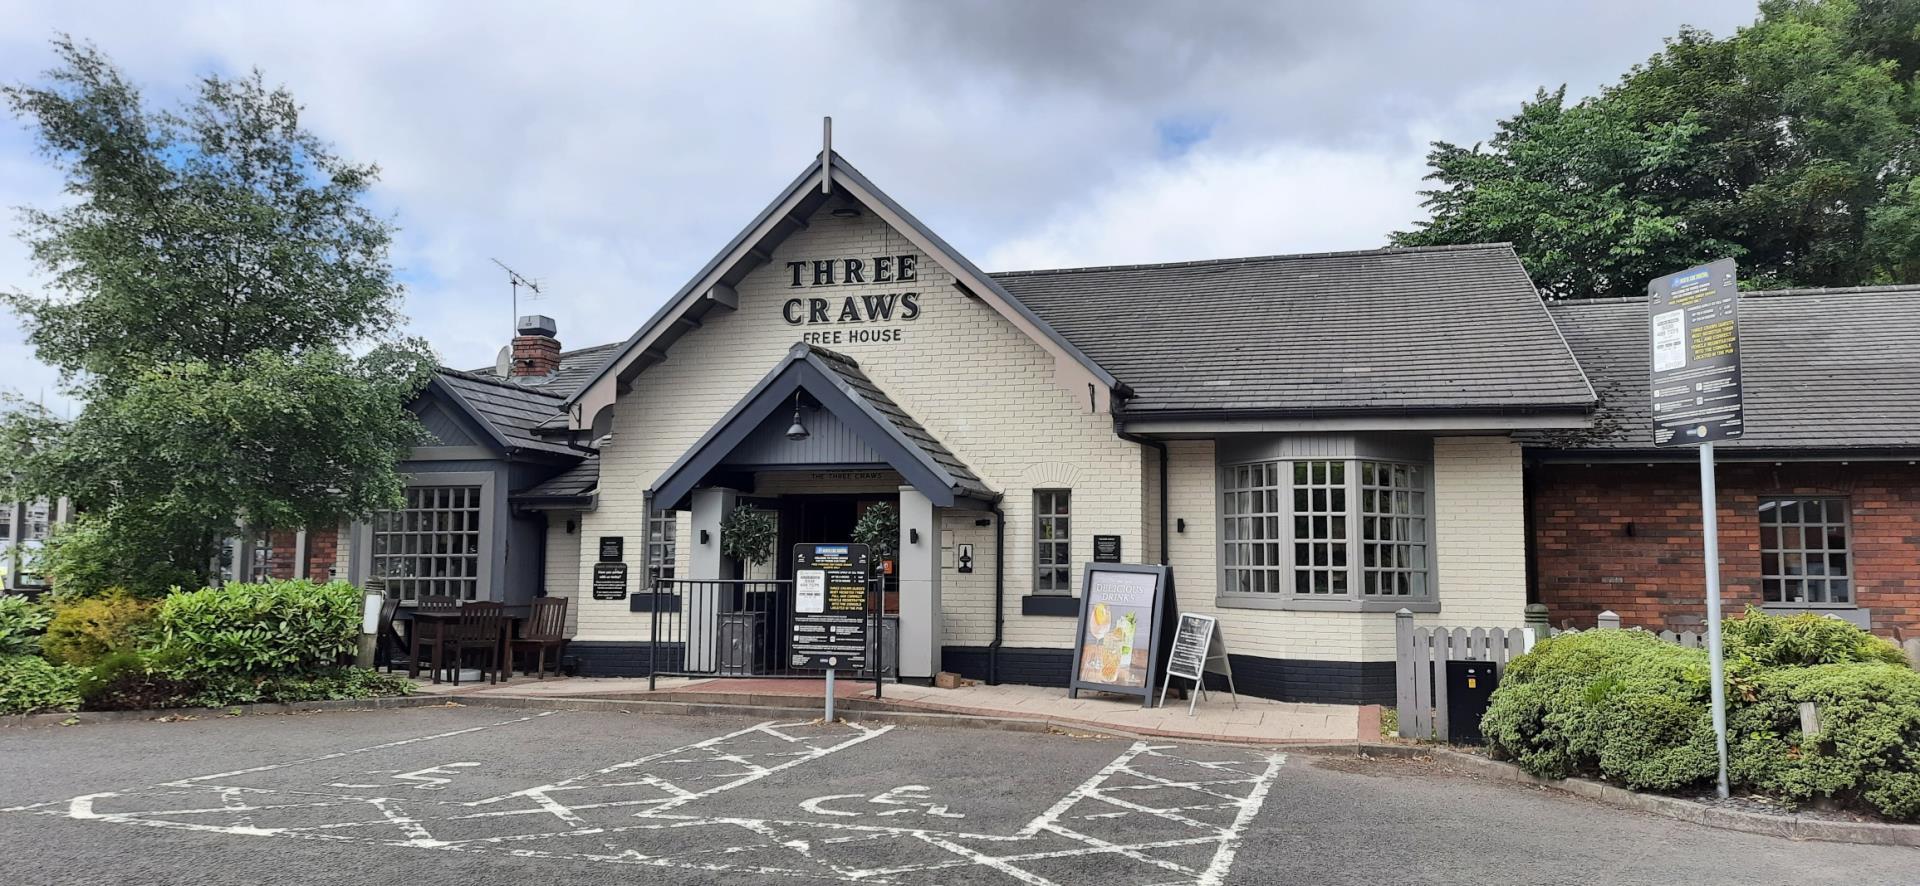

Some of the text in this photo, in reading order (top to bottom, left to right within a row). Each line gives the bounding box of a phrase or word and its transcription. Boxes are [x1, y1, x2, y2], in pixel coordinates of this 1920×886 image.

[786, 255, 917, 287] THREE
[783, 292, 920, 324] CRAWS
[803, 329, 901, 344] FREE HOUSE
[1096, 583, 1145, 594] DELICIOUS
[1102, 592, 1136, 603] DRINKS
